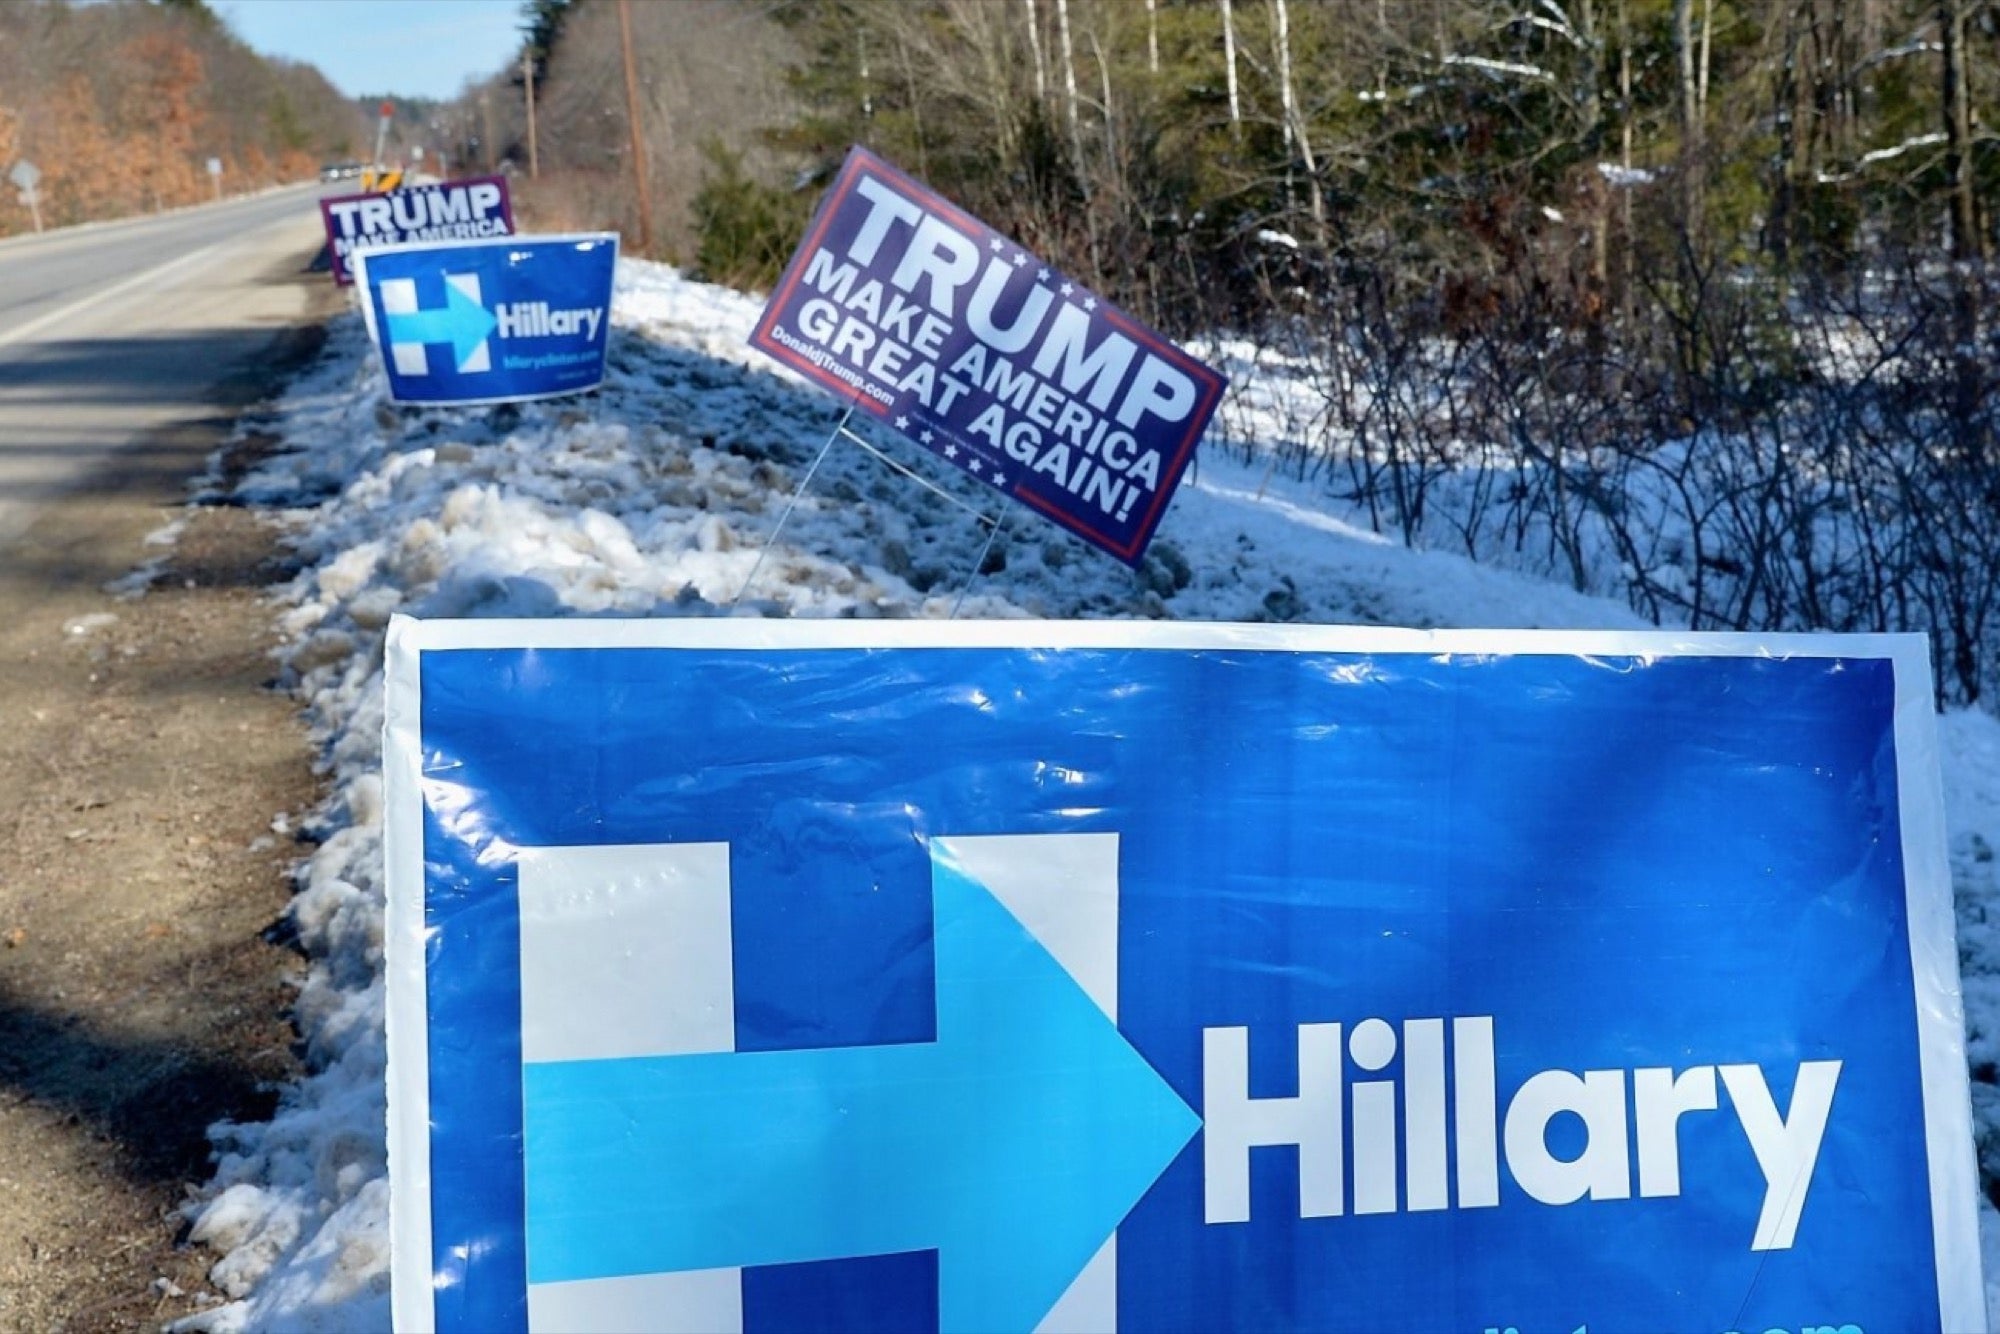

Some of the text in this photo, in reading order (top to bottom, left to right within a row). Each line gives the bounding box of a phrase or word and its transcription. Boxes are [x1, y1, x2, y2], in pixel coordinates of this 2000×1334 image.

[329, 183, 501, 237] TRUMP
[495, 301, 603, 342] Hillary
[847, 175, 1196, 430] TRUMP
[798, 300, 971, 416] GREAT
[967, 404, 1141, 523] AGAIN!
[802, 248, 953, 359] MAKE
[951, 344, 1162, 492] AMERICA
[1203, 1015, 1843, 1252] Hillary
